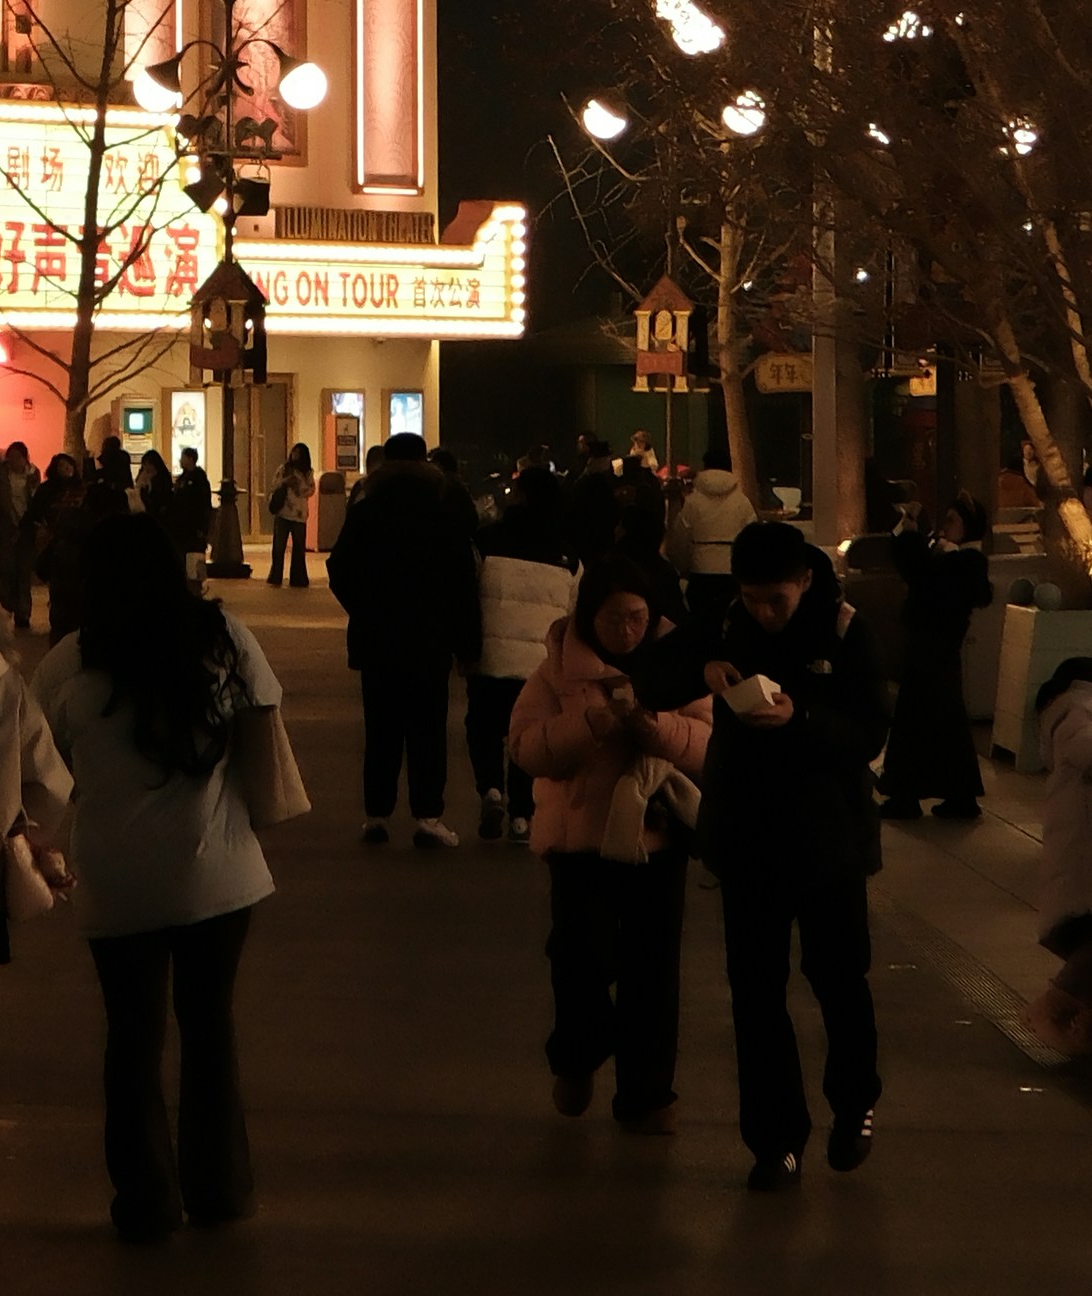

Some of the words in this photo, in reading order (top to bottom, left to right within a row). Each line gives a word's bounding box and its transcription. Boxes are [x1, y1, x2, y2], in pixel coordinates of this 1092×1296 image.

[104, 151, 159, 195] 欢迎
[282, 207, 378, 241] ILLUMINATION
[296, 271, 329, 307] ON
[338, 273, 399, 309] TOUR
[412, 276, 481, 309] 首次公演
